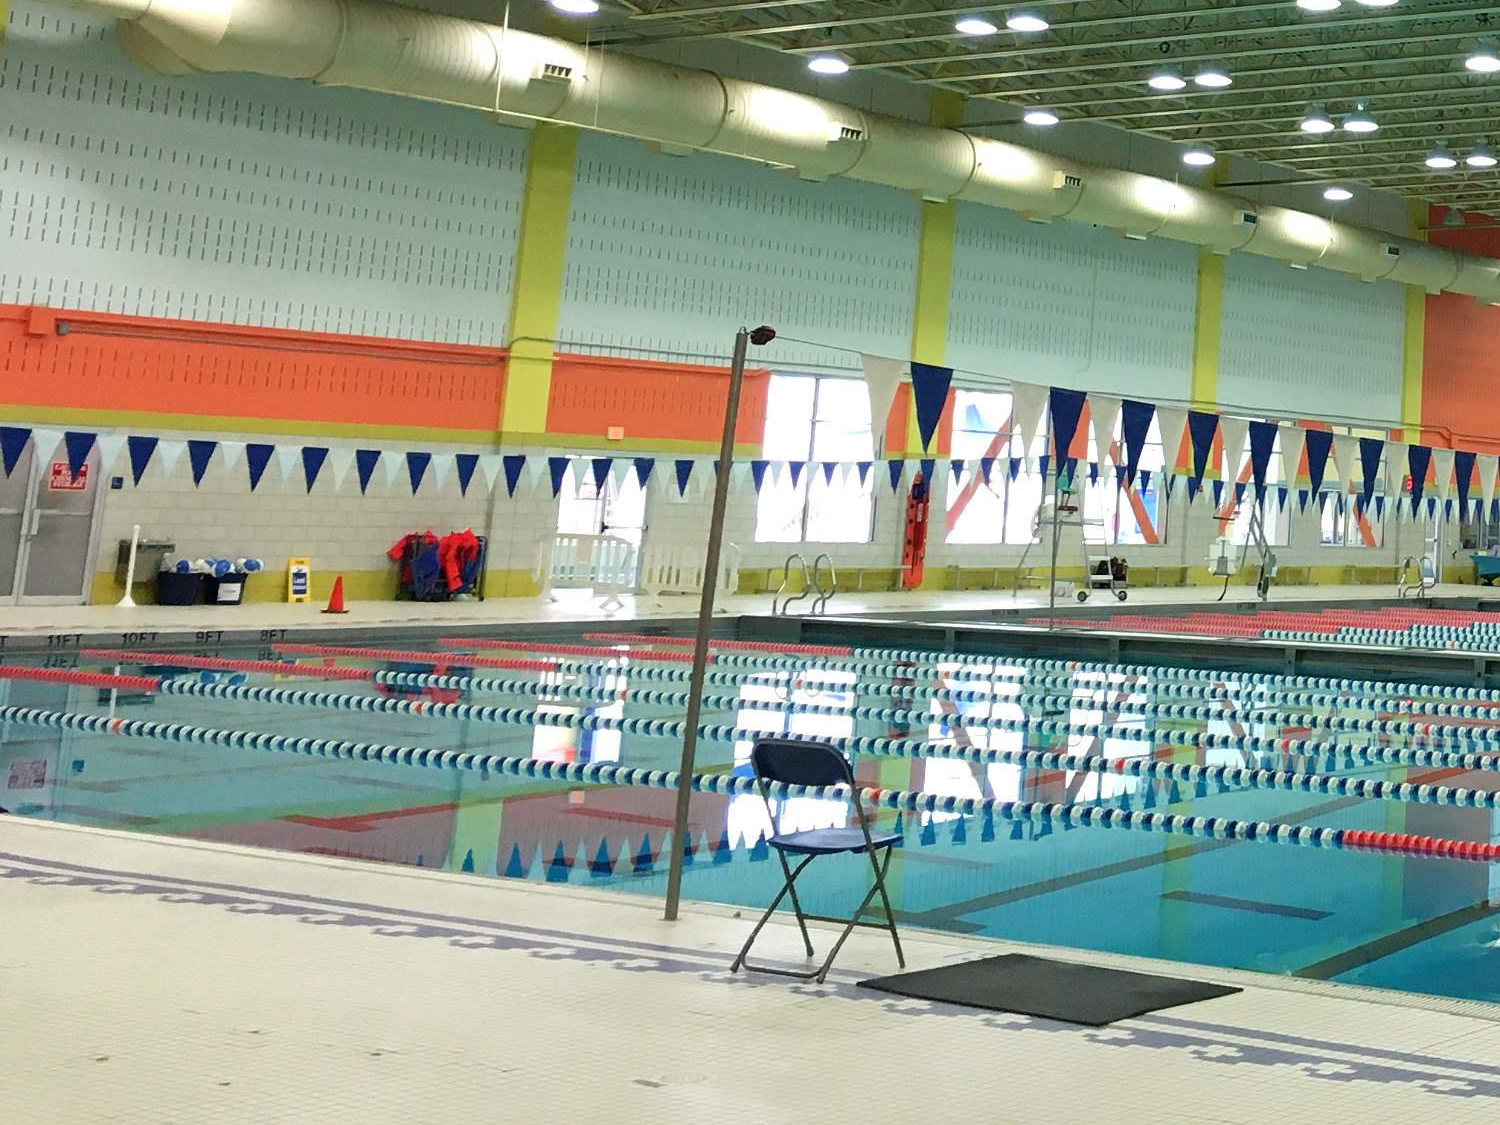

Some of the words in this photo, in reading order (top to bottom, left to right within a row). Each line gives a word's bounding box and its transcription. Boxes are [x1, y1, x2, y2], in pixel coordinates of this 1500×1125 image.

[47, 633, 83, 646] 11FT
[121, 632, 160, 644] 10FT
[195, 630, 224, 643] 9FT
[260, 629, 287, 641] 8FT
